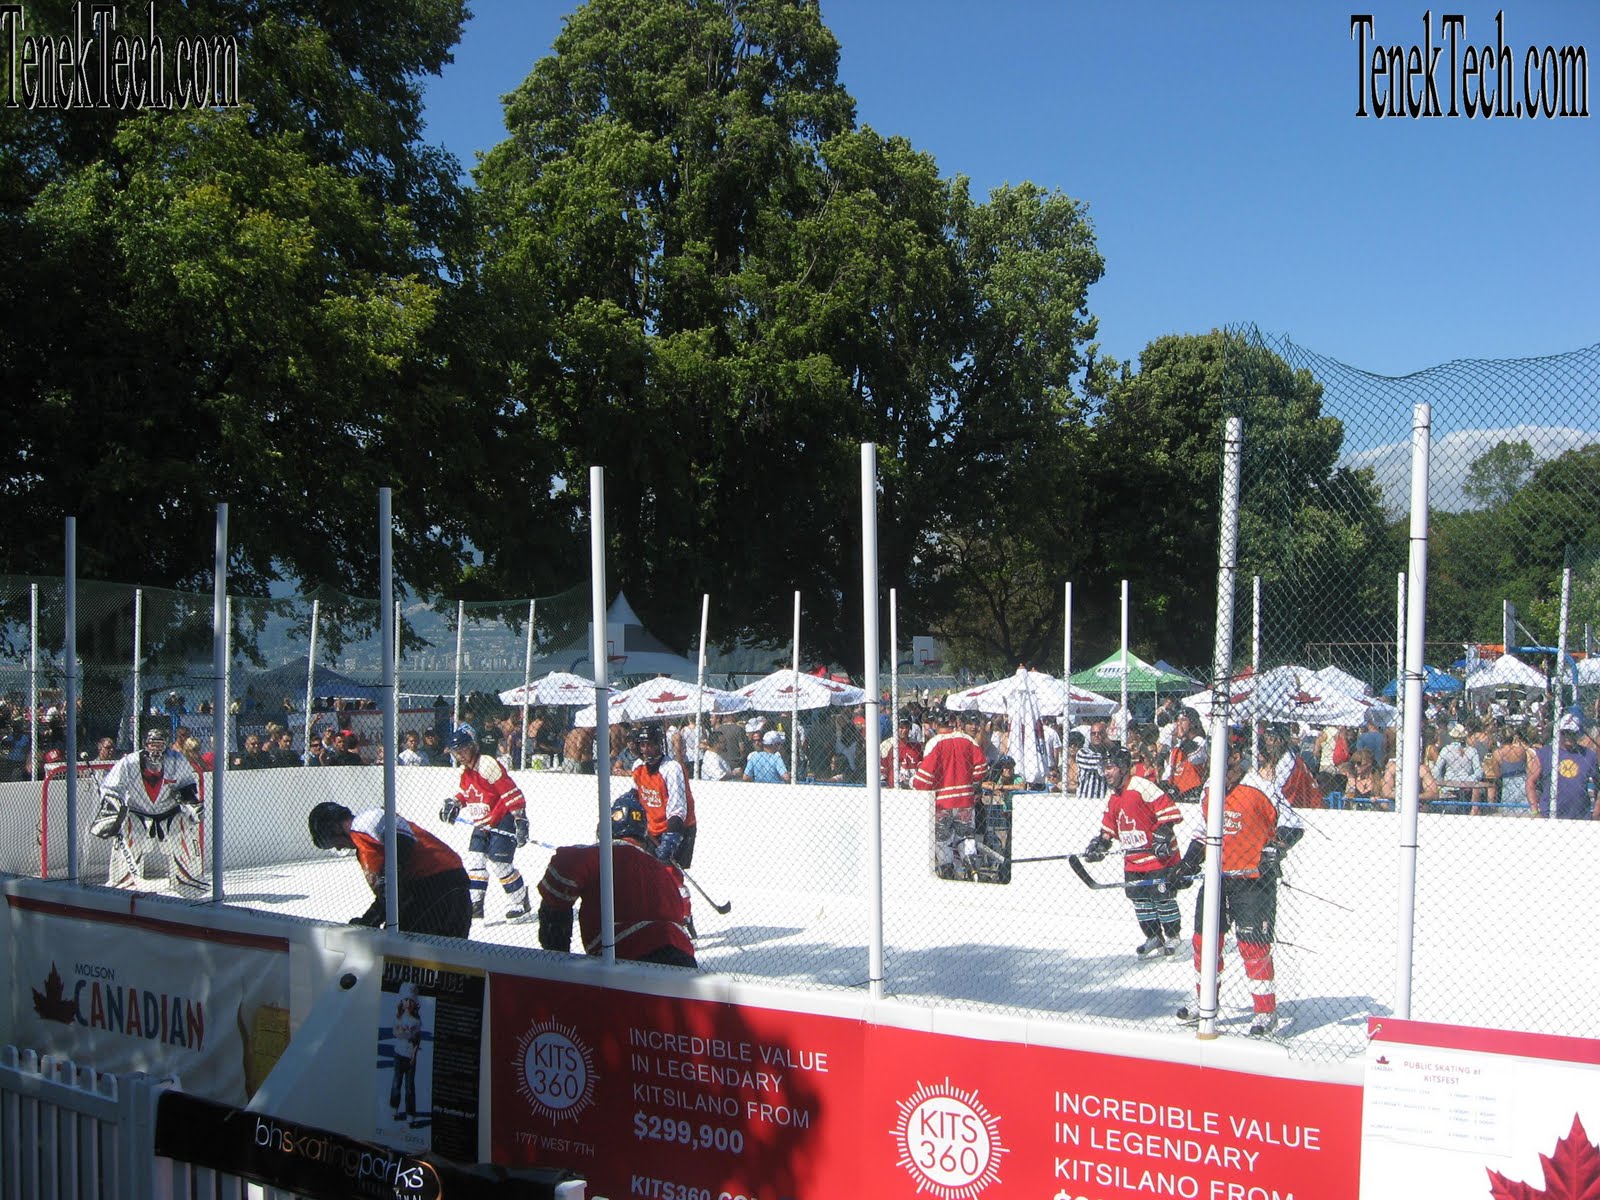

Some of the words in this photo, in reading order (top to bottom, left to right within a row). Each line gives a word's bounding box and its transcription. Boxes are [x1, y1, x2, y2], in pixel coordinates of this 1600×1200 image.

[631, 811, 642, 821] 12
[75, 962, 115, 981] MOLSON
[73, 979, 204, 1052] CANADIAN
[533, 1042, 577, 1074] KITS
[629, 1027, 752, 1063] INCREDIBLE
[759, 1045, 829, 1073] VALUE
[1403, 1060, 1433, 1071] PUBLIC
[1434, 1063, 1471, 1075] SKATING
[533, 1071, 579, 1102] 360
[631, 1053, 650, 1072] IN
[656, 1061, 783, 1094] LEGENDARY
[632, 1083, 739, 1117] KITSILANO
[746, 1100, 810, 1129] FROM
[920, 1107, 978, 1143] KITS
[1054, 1090, 1219, 1134] INCREDIBLE
[1228, 1115, 1322, 1152] VALUE
[514, 1131, 539, 1146] 1777
[541, 1137, 570, 1152] WEST
[573, 1142, 596, 1157] 7TH
[633, 1110, 745, 1154] $299,900
[1054, 1122, 1080, 1146] IN
[1090, 1129, 1260, 1173] LEGENDARY
[920, 1139, 980, 1176] 360
[1054, 1157, 1199, 1199] KITSILANO
